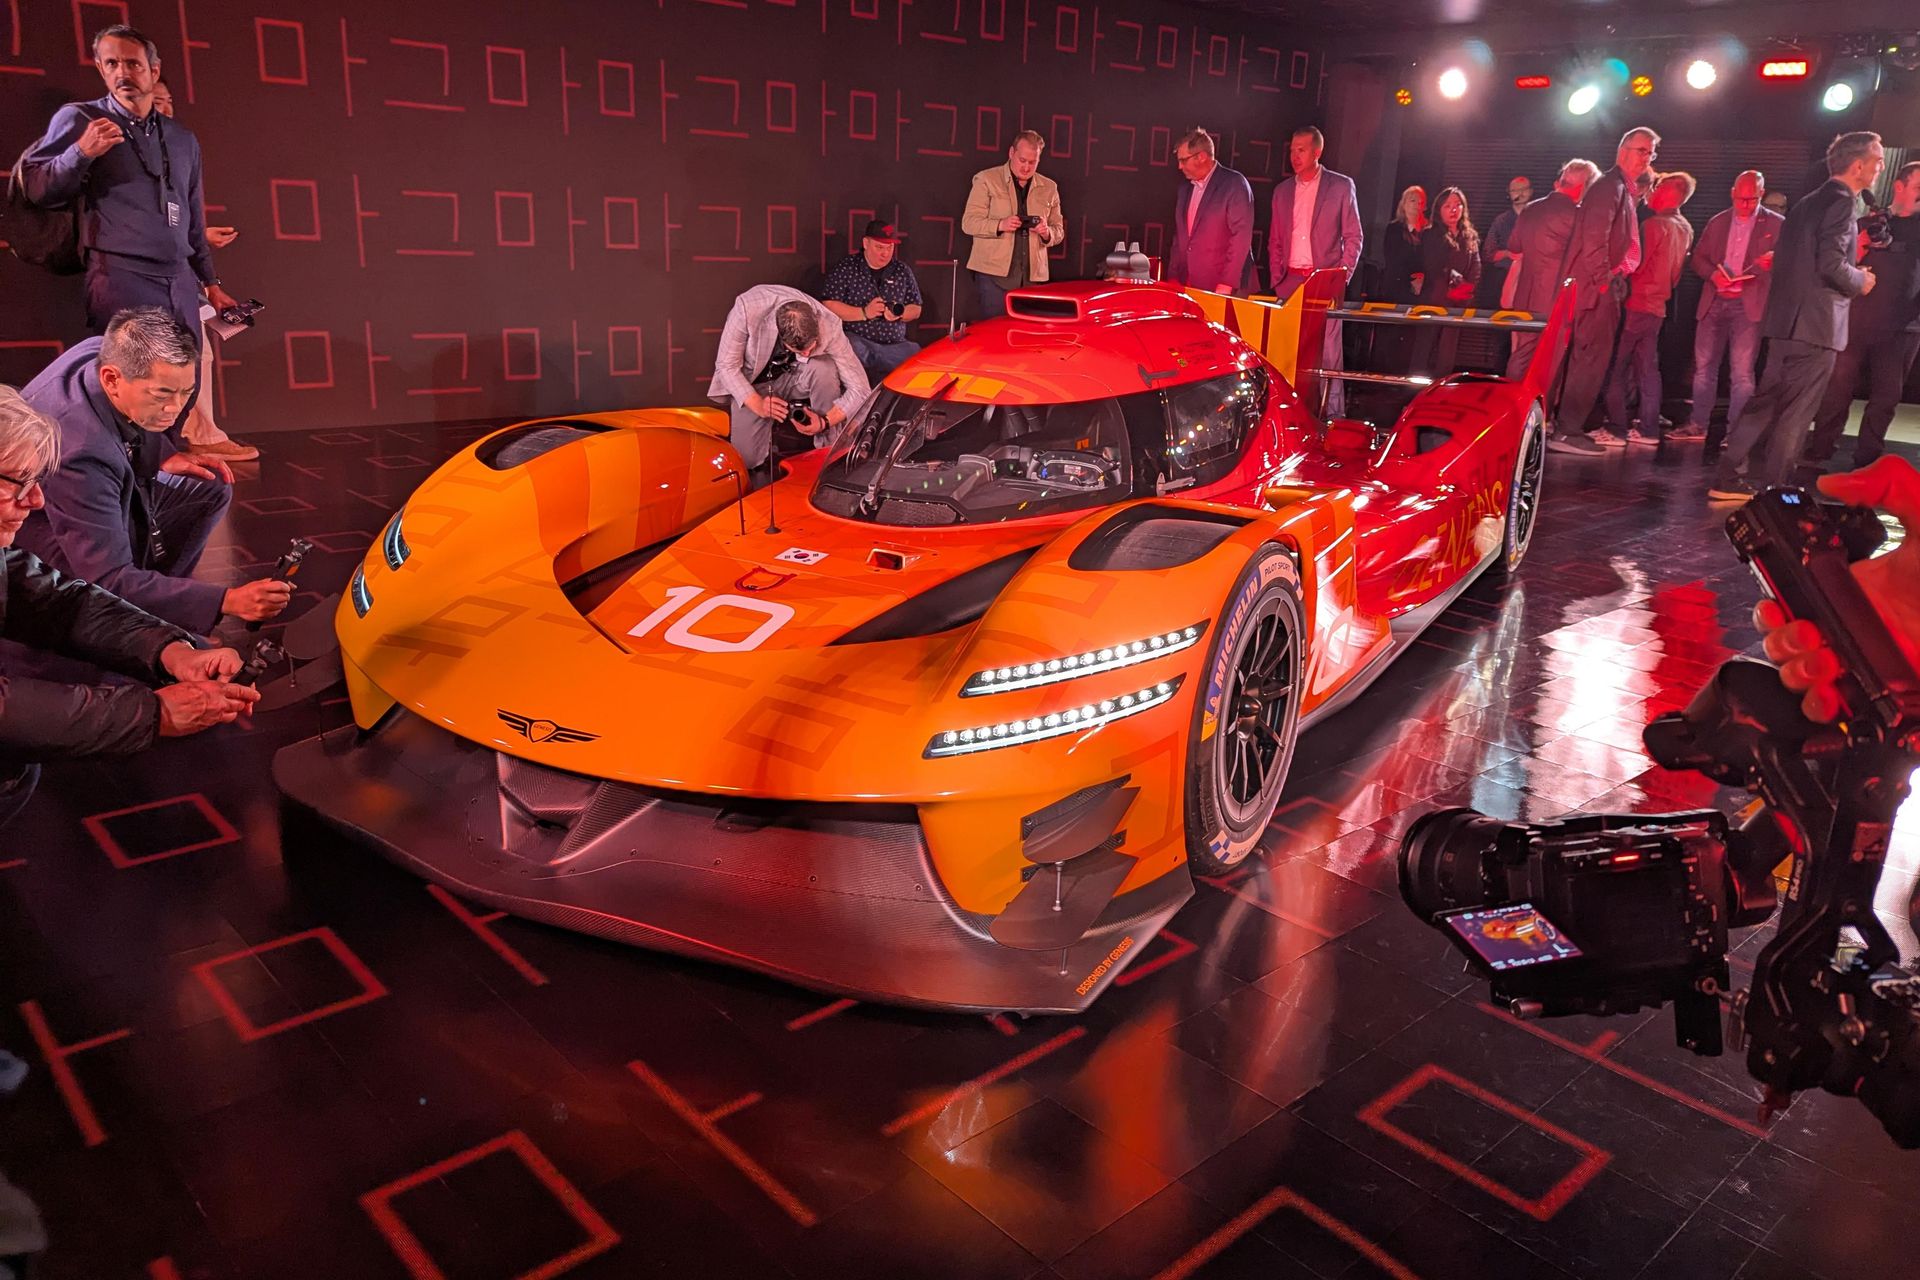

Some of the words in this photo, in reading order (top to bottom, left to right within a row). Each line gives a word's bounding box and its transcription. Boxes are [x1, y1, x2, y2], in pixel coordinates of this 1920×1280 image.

[1264, 562, 1277, 577] PILOT
[1277, 561, 1291, 572] SPORT
[626, 585, 796, 653] 10
[1214, 576, 1258, 689] MICHELIN
[1075, 964, 1108, 996] DESIGNED
[1102, 956, 1114, 968] BY
[1109, 936, 1134, 961] GENESIS
